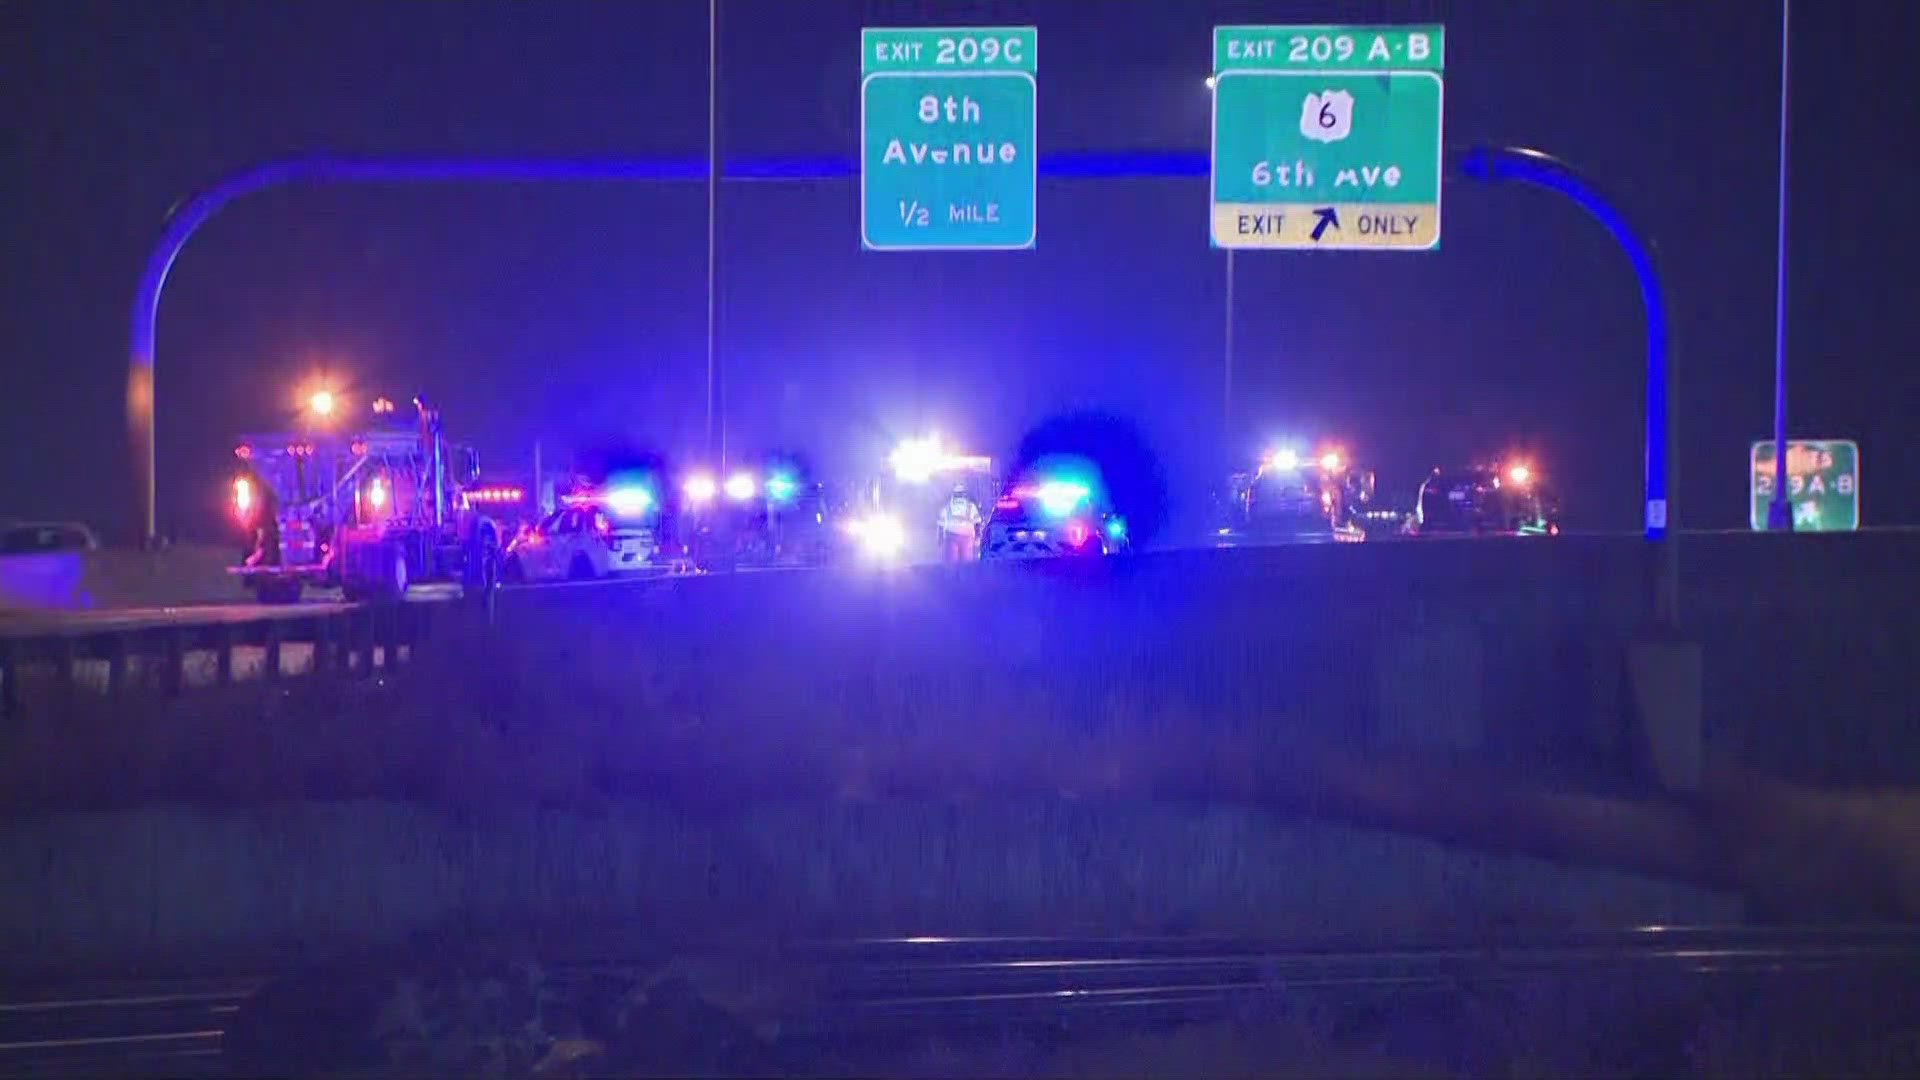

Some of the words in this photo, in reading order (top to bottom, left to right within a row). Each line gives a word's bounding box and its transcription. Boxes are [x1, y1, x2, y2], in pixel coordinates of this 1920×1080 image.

[876, 42, 923, 61] EXIT
[936, 38, 1022, 64] 209C
[1227, 40, 1275, 59] EXIT
[1289, 36, 1354, 61] 209
[919, 95, 980, 123] 8th
[1319, 102, 1336, 128] 6
[883, 139, 1015, 164] Avenue
[1252, 160, 1313, 187] 6th
[949, 204, 999, 223] MILE
[1238, 216, 1284, 234] EXIT
[1358, 216, 1417, 234] ONLY
[1758, 475, 1803, 495] 29
